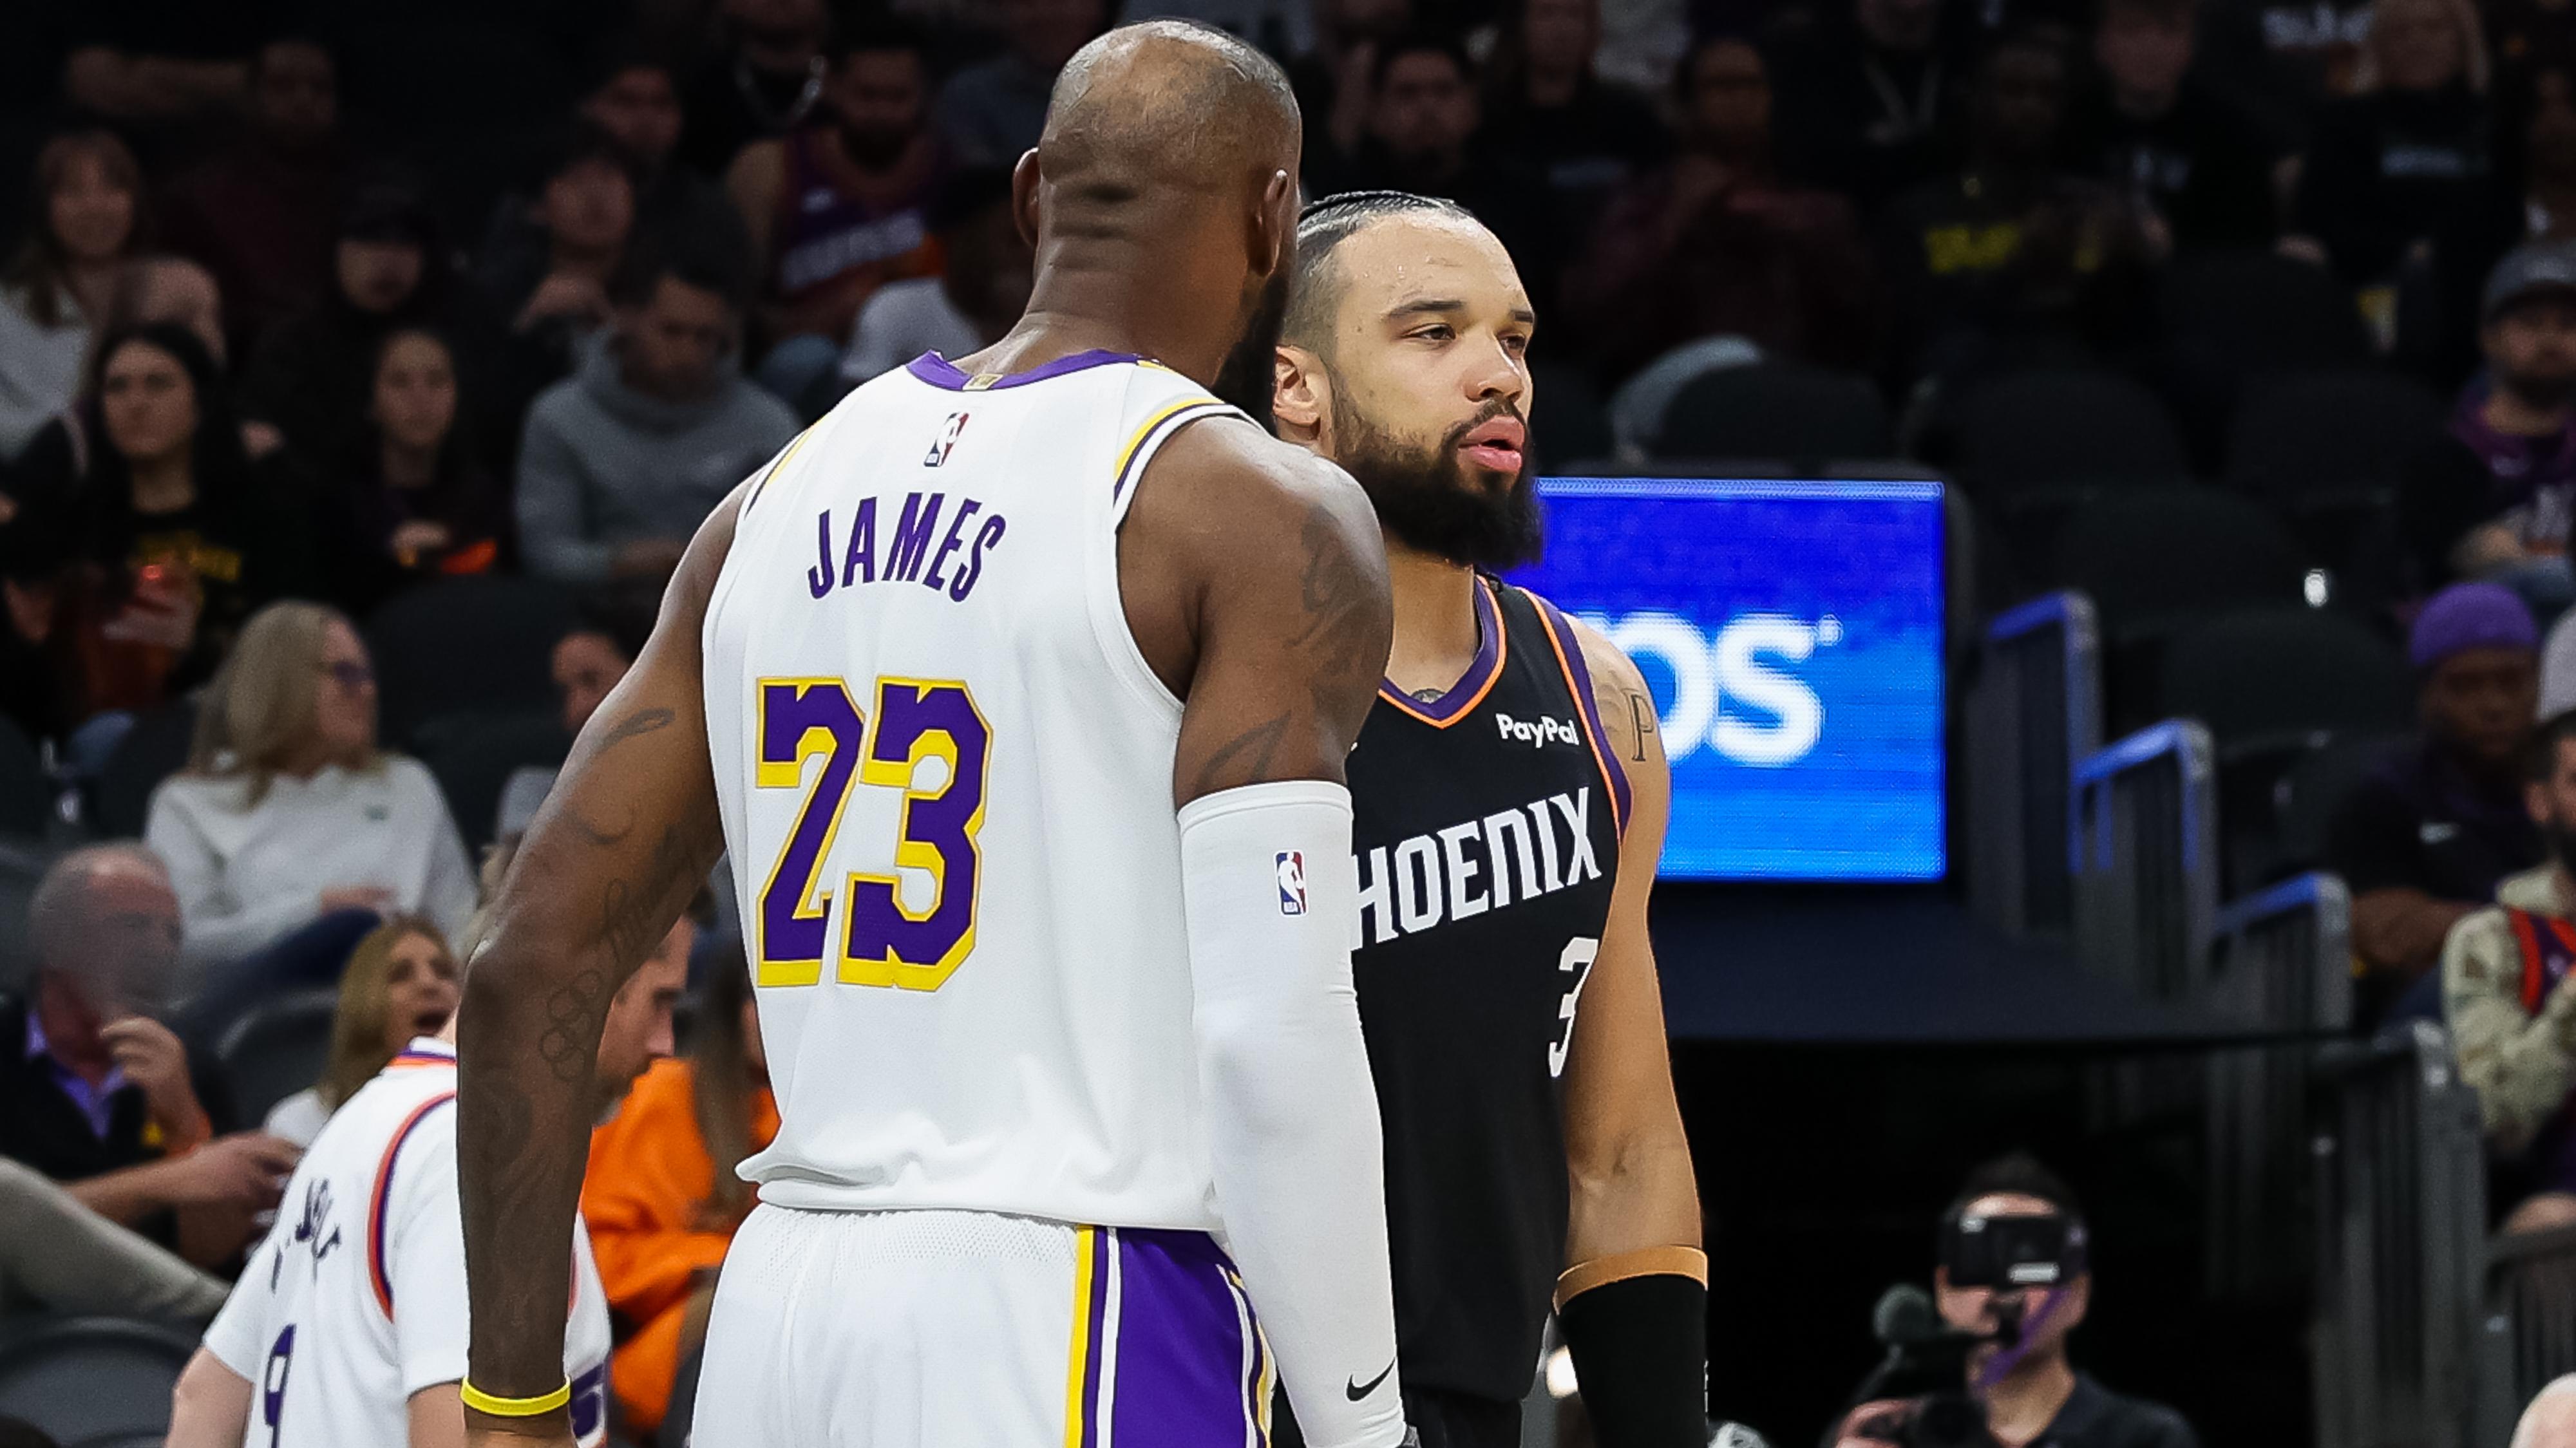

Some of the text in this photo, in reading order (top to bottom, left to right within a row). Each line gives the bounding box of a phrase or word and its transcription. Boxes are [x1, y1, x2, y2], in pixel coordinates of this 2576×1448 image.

[808, 493, 1006, 603] JAMES
[1495, 713, 1580, 748] PayPal
[1579, 609, 1824, 767] OS
[756, 675, 994, 992] 23
[1350, 787, 1602, 951] HOENIX
